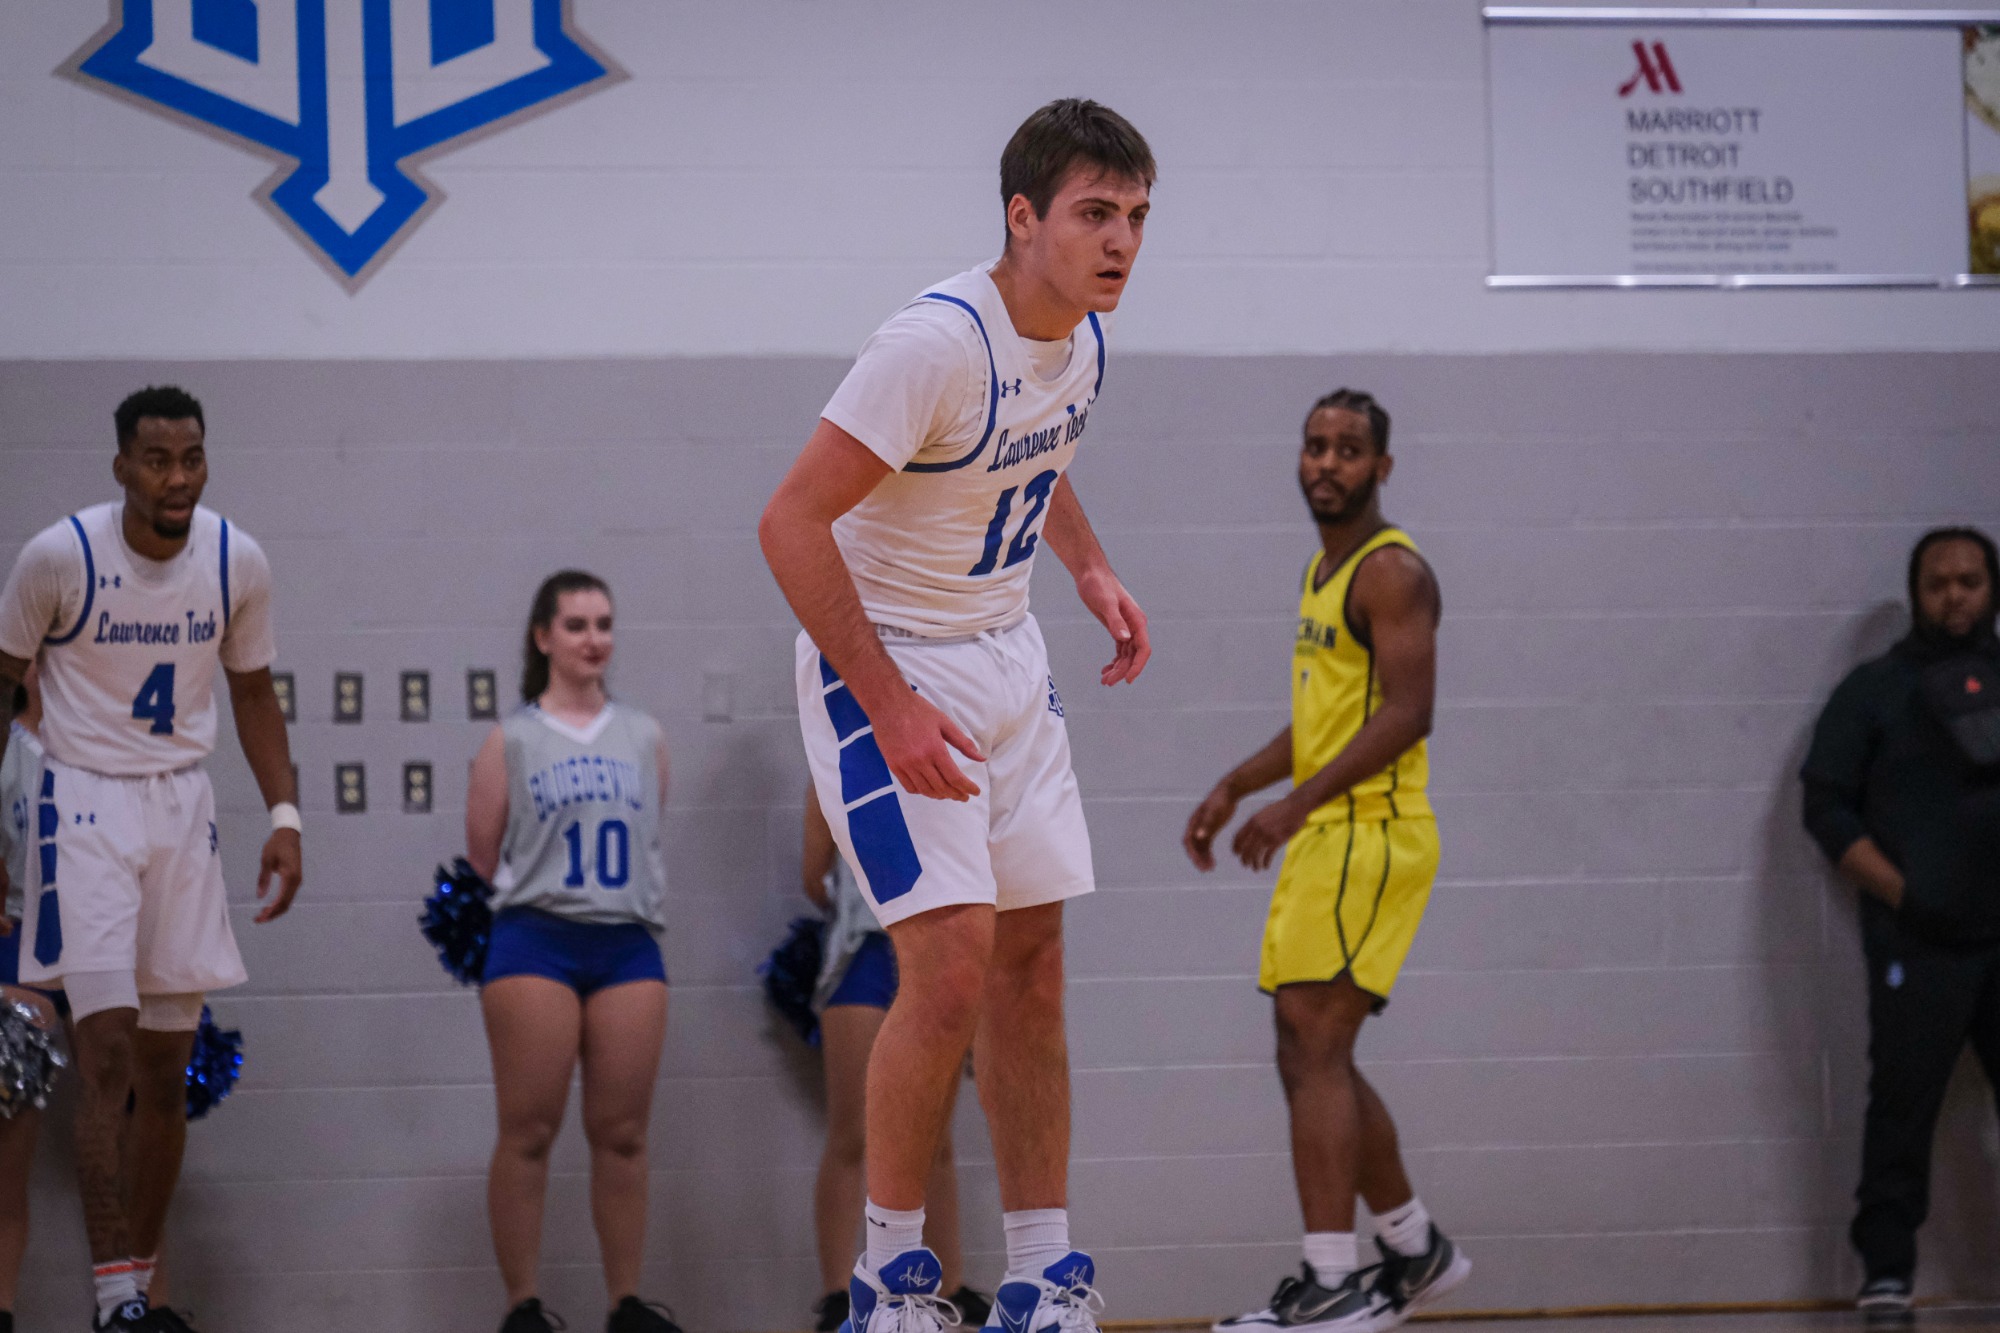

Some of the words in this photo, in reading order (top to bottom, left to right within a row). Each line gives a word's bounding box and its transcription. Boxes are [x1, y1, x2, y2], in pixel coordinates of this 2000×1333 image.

[1626, 106, 1762, 134] MARRIOTT
[1626, 141, 1740, 170] DETROIT
[1628, 176, 1794, 204] SOUTHFIELD
[987, 425, 1062, 472] Lawrence
[968, 469, 1058, 576] 12
[94, 610, 180, 645] Lawrence
[186, 610, 217, 645] Tech
[132, 663, 175, 736] 4
[562, 819, 630, 889] 10
